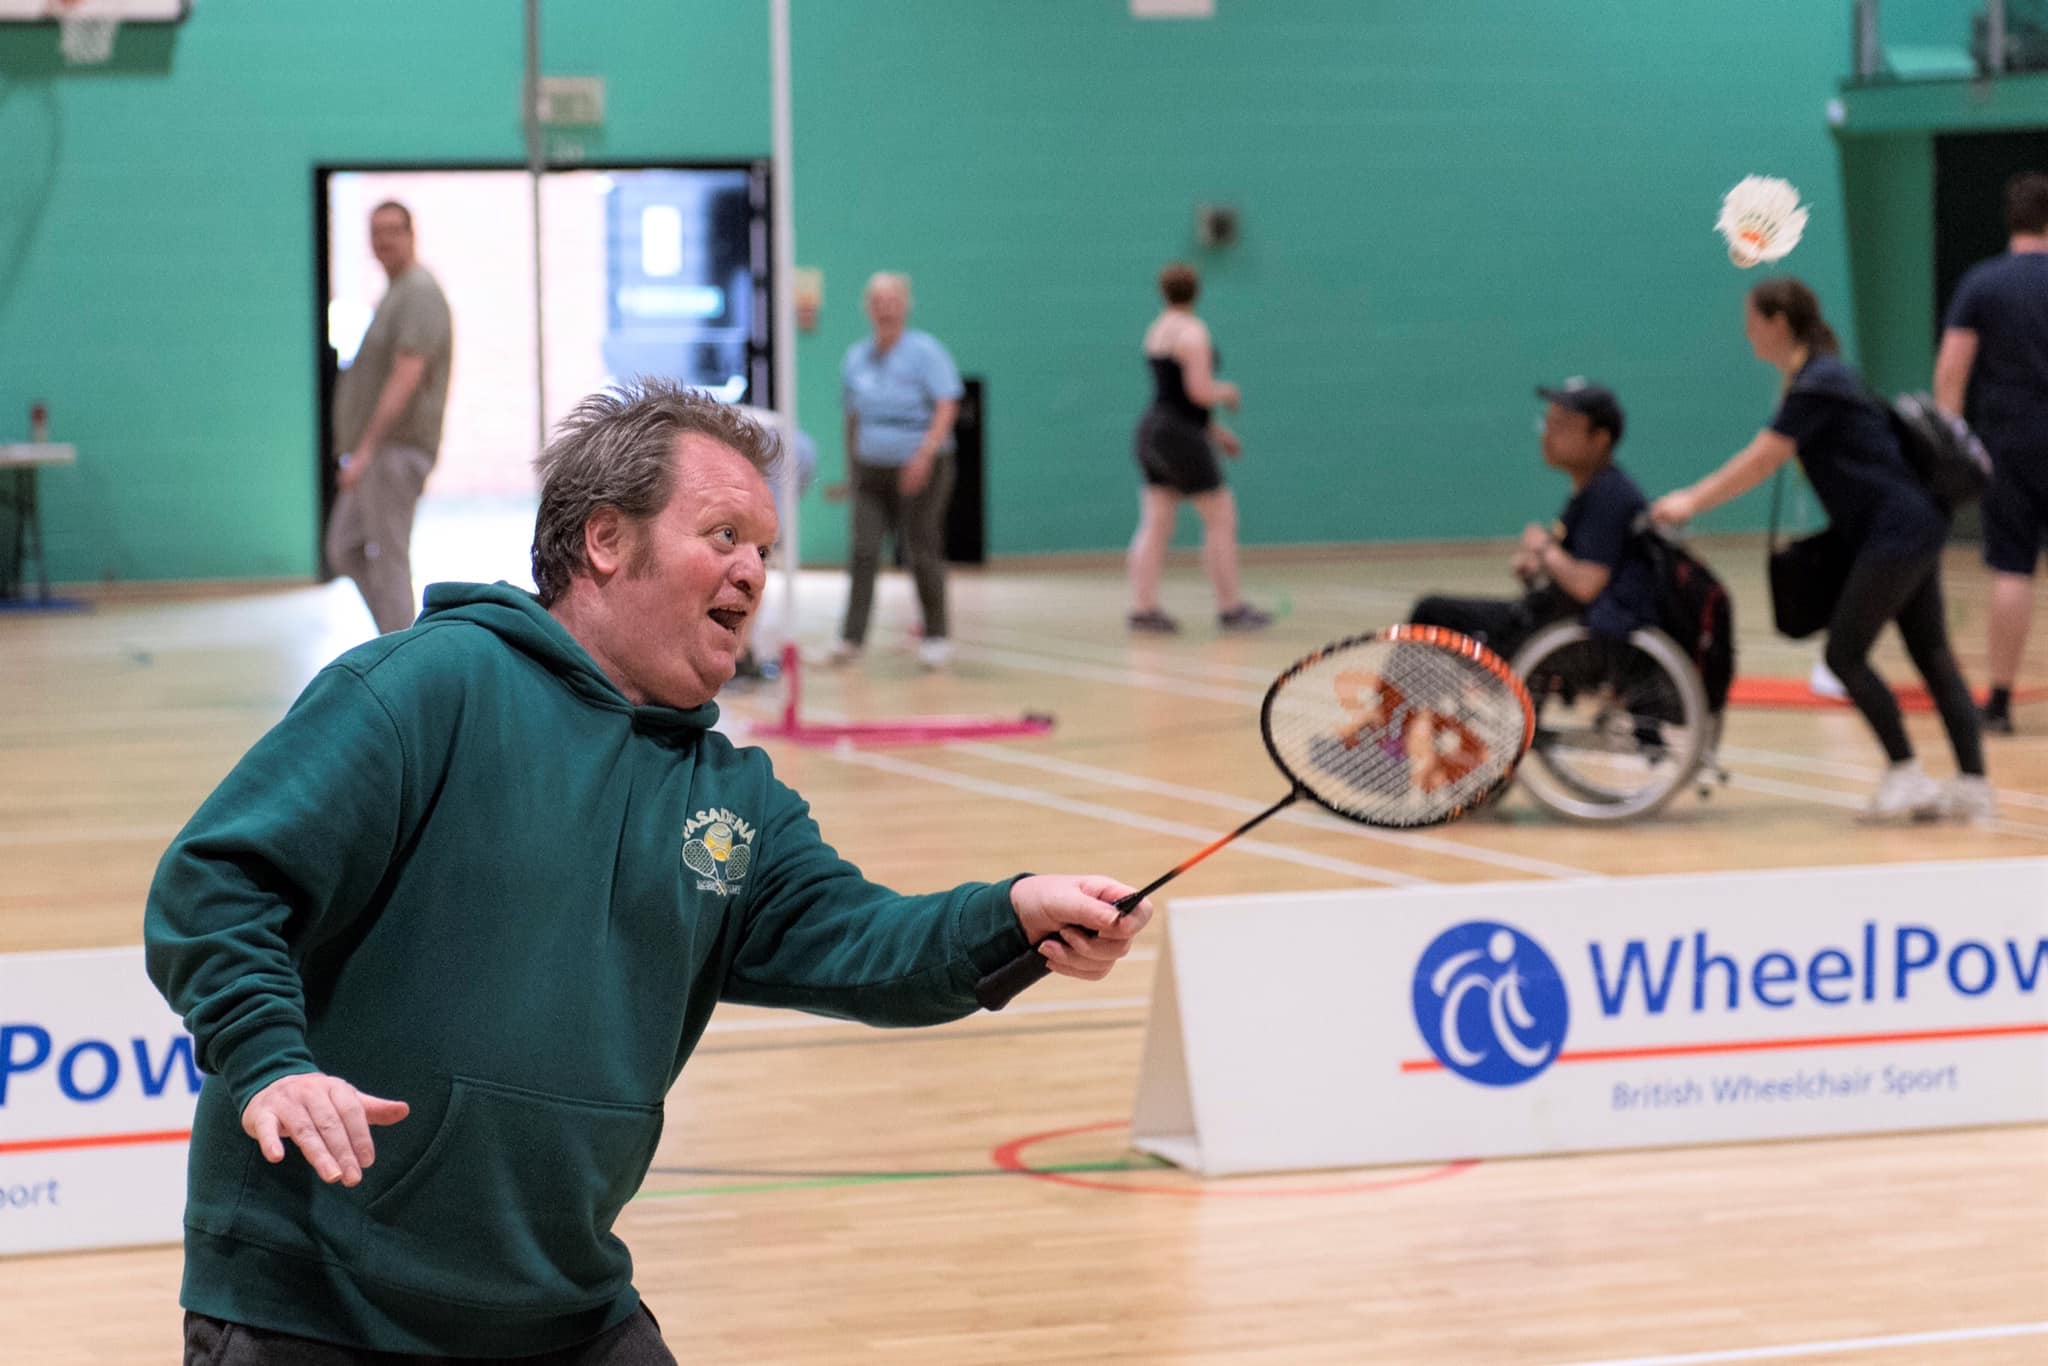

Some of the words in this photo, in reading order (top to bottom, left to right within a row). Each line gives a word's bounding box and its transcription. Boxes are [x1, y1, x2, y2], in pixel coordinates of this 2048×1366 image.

[1612, 1079, 1704, 1110] British
[1713, 1068, 1872, 1104] Wheelchair
[1883, 1064, 1959, 1095] Sport
